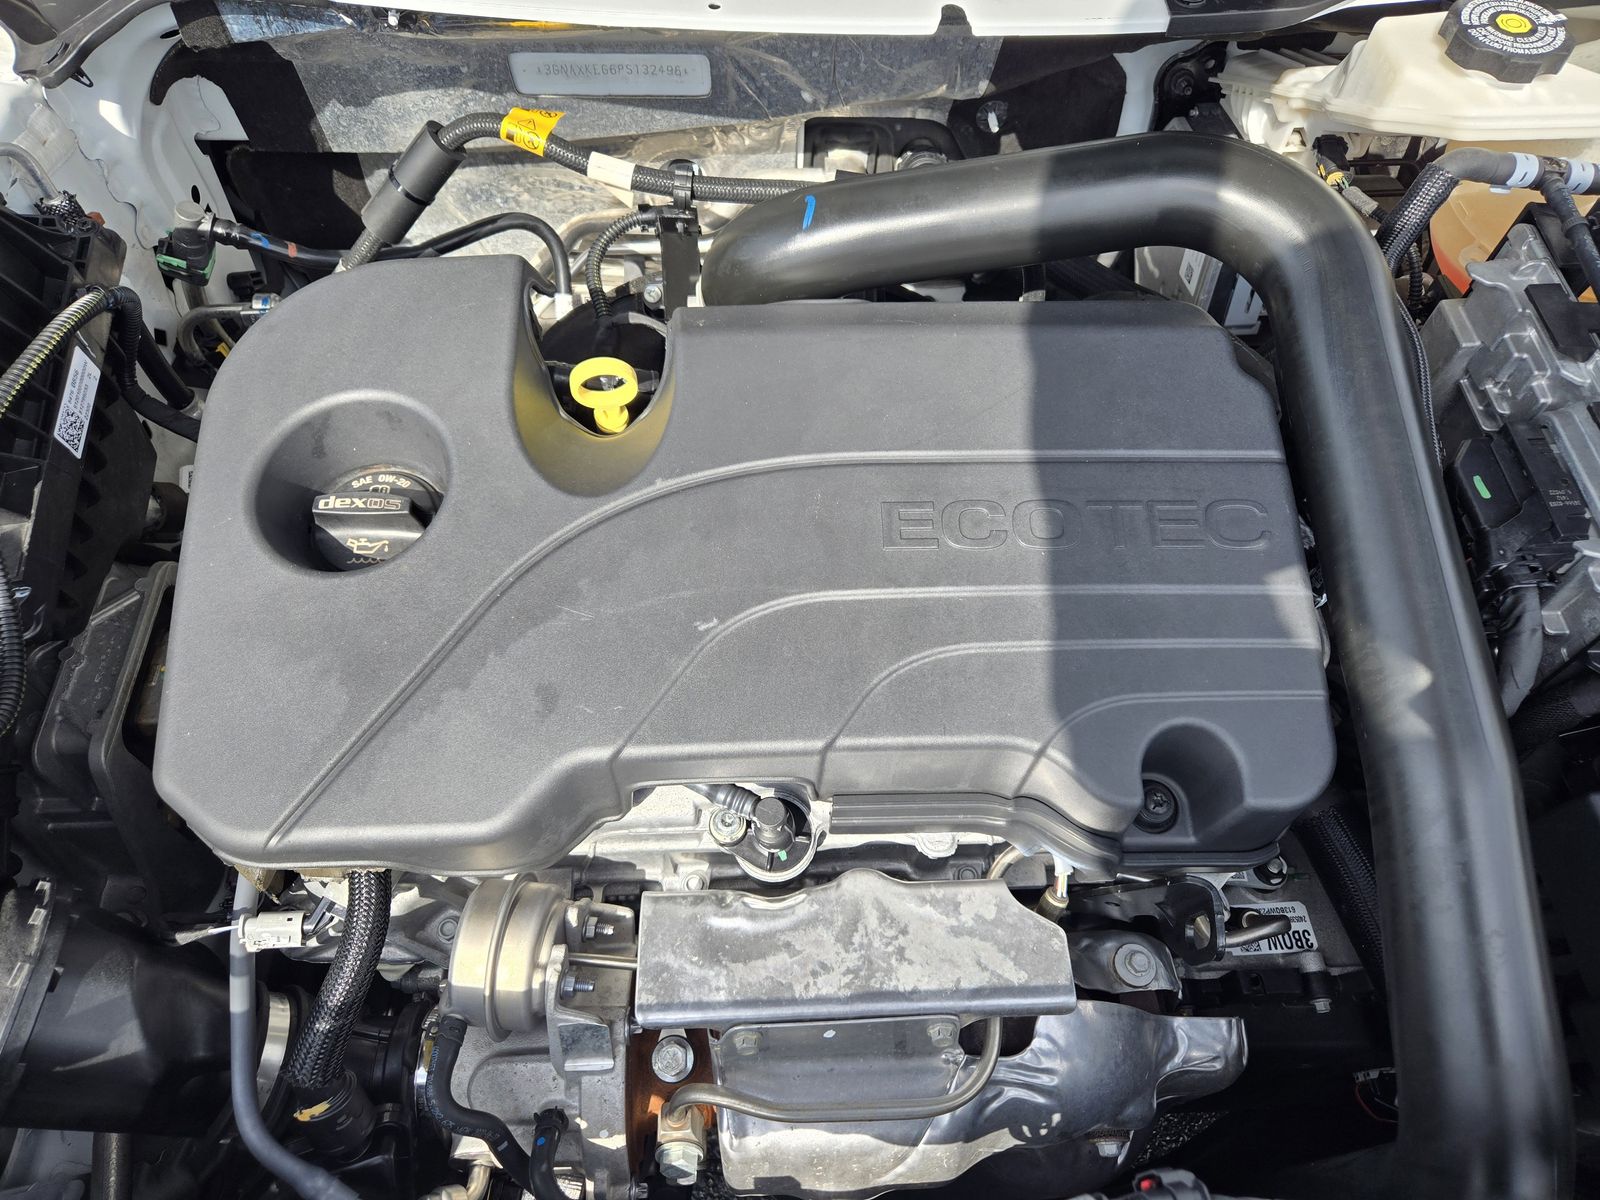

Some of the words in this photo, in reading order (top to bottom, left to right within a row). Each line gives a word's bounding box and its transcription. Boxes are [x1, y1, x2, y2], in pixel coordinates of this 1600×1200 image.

[1481, 38, 1503, 50] FLUID
[1502, 45, 1525, 54] FROM
[351, 475, 373, 488] SAE
[377, 474, 412, 488] 0W-20
[318, 495, 402, 511] dexos
[880, 499, 1272, 550] ECOTEC
